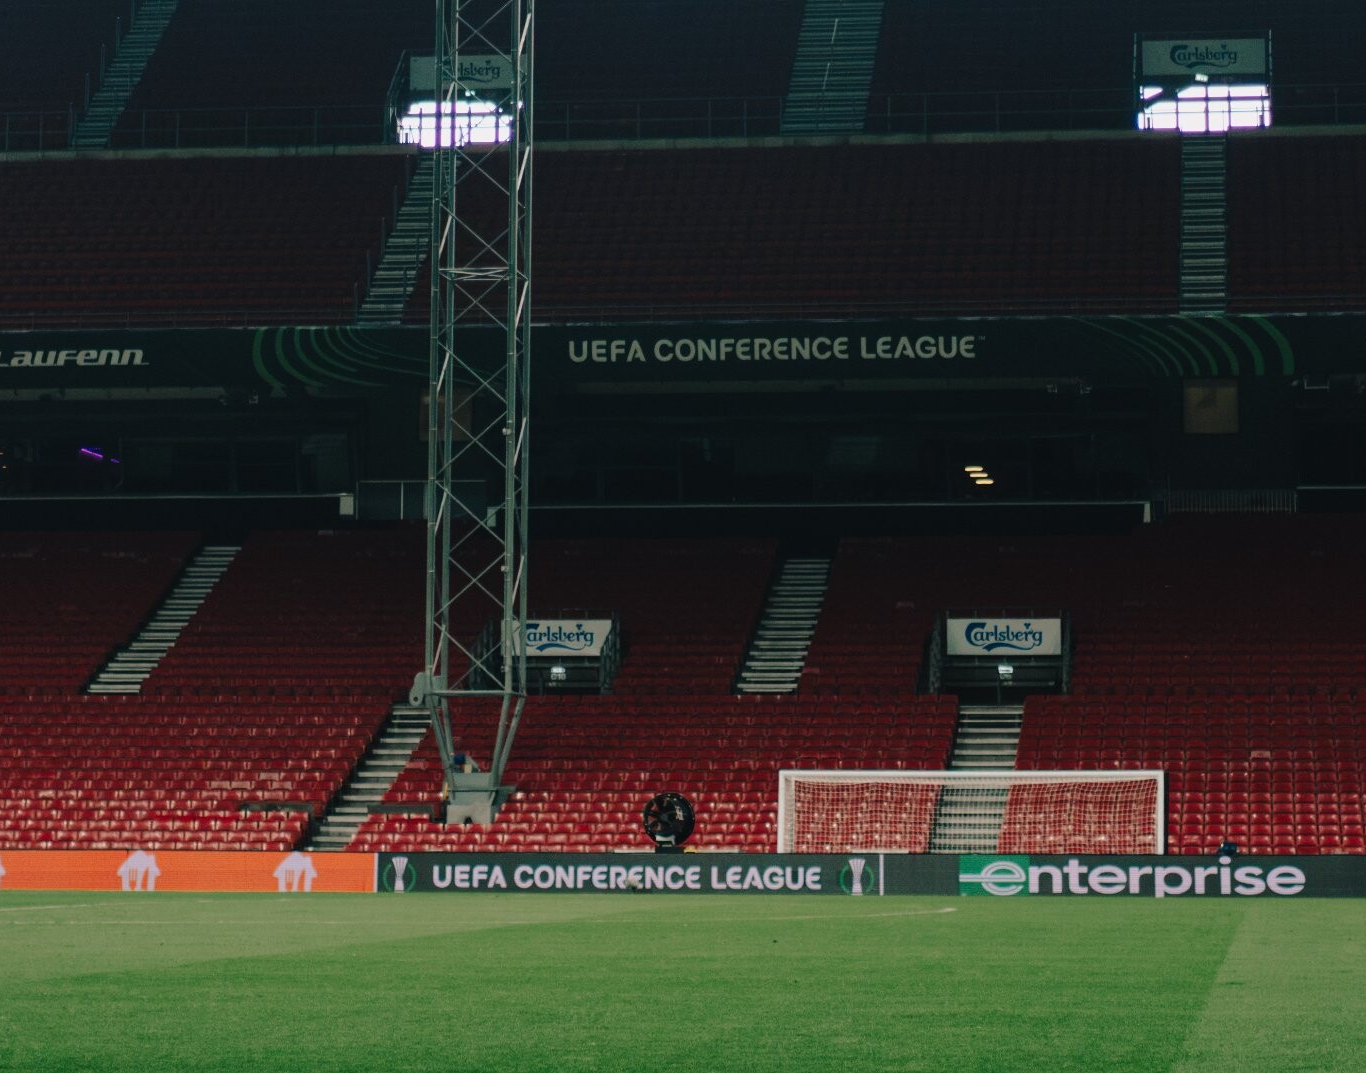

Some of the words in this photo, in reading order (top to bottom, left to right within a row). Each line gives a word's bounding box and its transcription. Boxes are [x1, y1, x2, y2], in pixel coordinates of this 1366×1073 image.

[1170, 44, 1237, 69] Carlsberg
[568, 339, 646, 363] UEFA
[653, 337, 849, 362] CONFERENCE
[860, 335, 977, 359] LEAGUE
[965, 622, 1043, 652] Carlsberg
[433, 865, 507, 890] UEFA
[514, 865, 702, 890] CONFERENCE
[711, 866, 822, 890] LEAGUE
[959, 856, 1306, 897] enterprise
